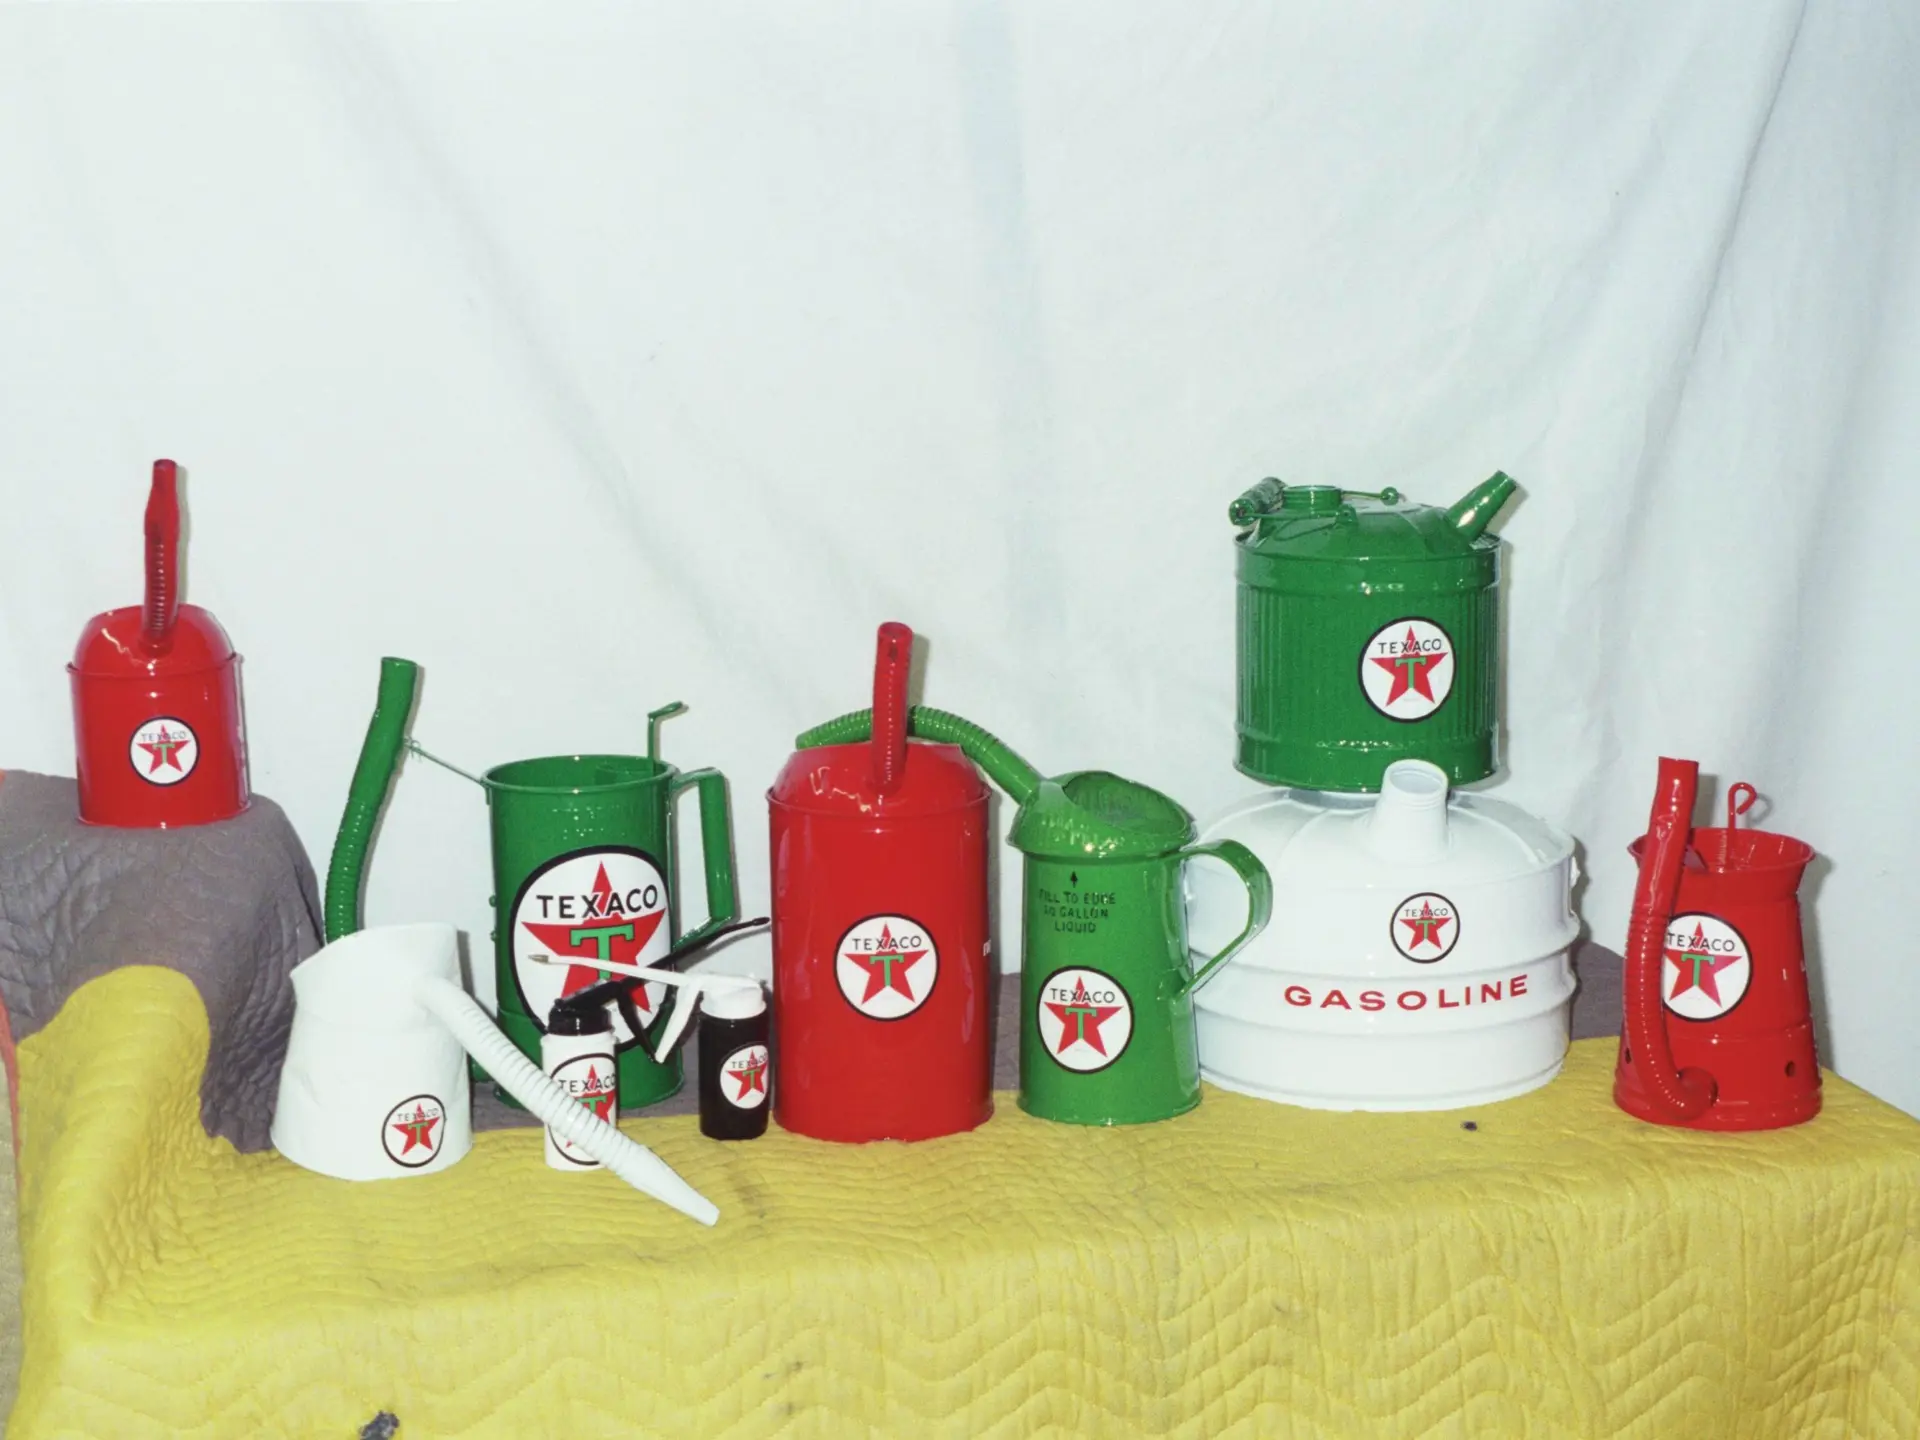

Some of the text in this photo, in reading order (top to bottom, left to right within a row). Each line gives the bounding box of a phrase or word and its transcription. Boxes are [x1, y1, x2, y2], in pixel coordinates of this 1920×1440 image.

[1378, 638, 1442, 654] TEXACO
[536, 884, 658, 918] TEXACO
[1060, 906, 1108, 919] GALLON
[1404, 908, 1448, 917] TEXACO
[1055, 921, 1096, 933] LIQUID
[852, 935, 922, 951] TEXACO
[1668, 933, 1735, 952] TEXACO
[1050, 988, 1115, 1003] TEXACO
[1284, 974, 1527, 1011] GASOLINE
